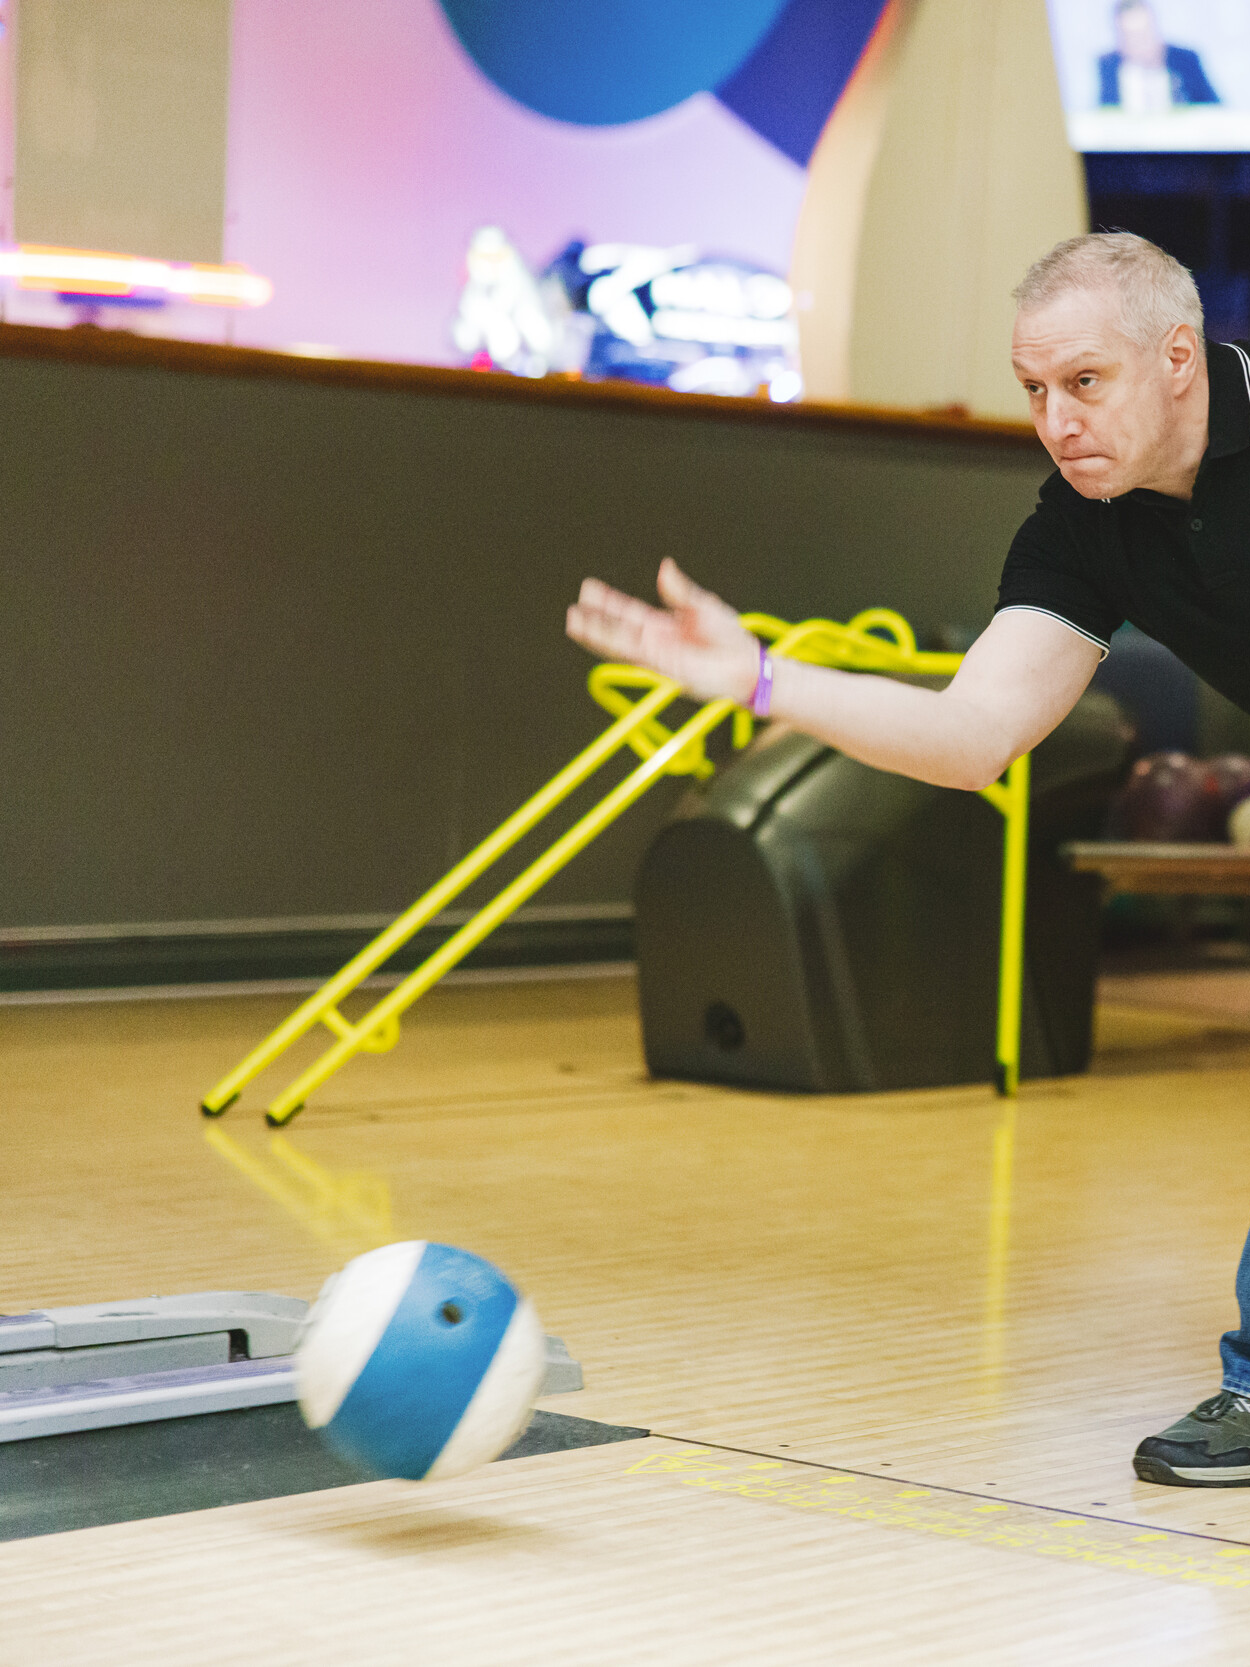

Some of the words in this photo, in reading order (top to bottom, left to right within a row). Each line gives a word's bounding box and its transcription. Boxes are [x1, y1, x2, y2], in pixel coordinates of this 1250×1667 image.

[681, 1477, 828, 1508] FLOOR
[734, 1474, 811, 1491] LINE
[822, 1506, 1034, 1547] SLIPPERY
